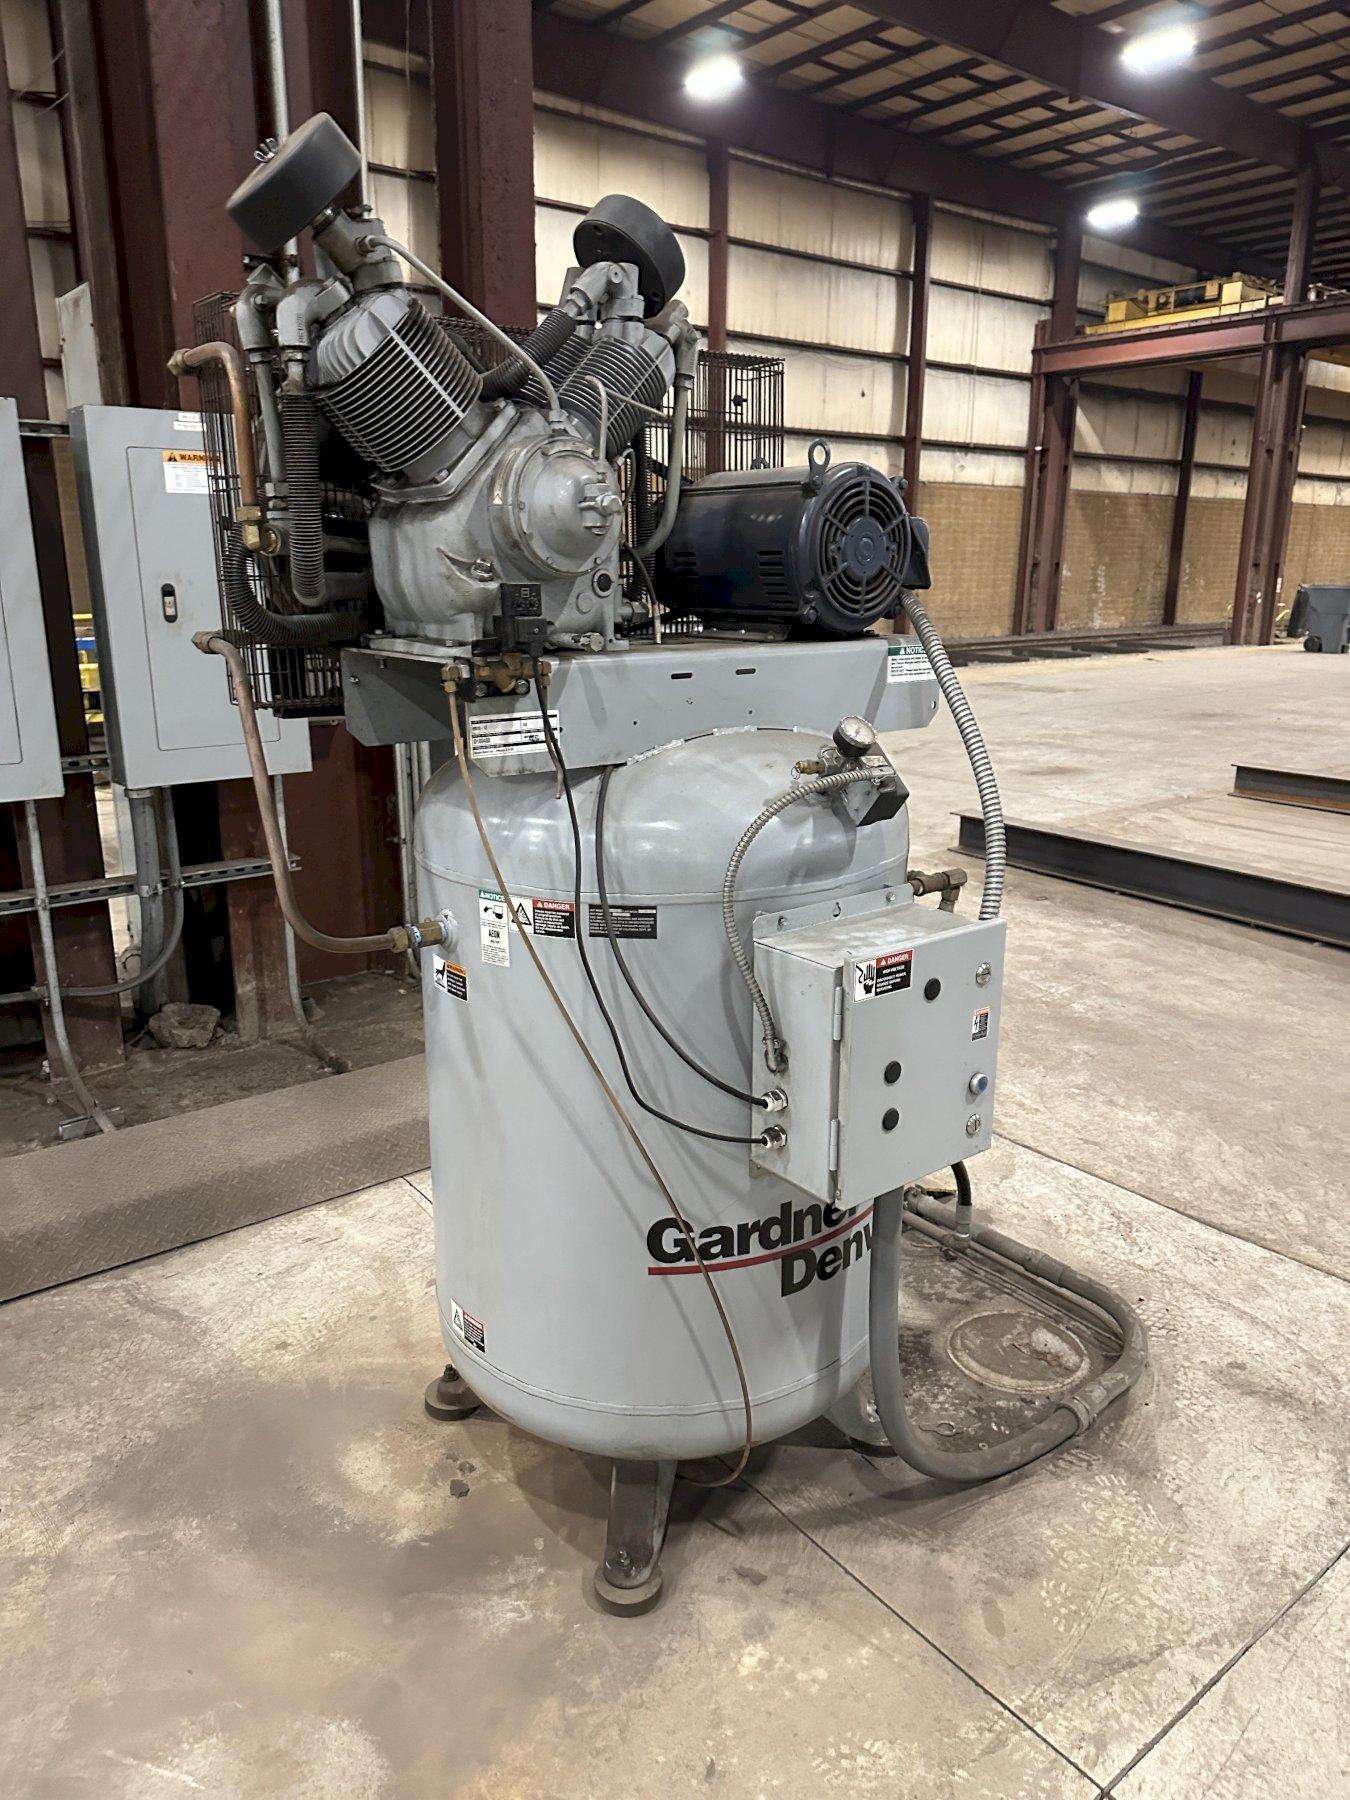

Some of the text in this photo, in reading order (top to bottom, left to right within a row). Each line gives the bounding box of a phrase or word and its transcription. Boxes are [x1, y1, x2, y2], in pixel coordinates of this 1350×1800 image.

[179, 453, 221, 462] WARN
[906, 646, 926, 655] NOTIC
[485, 891, 506, 902] NOTICE
[543, 902, 570, 910] DANGER
[887, 953, 909, 964] DANGER
[647, 1200, 857, 1264] Gardne
[781, 1222, 873, 1298] Denv
